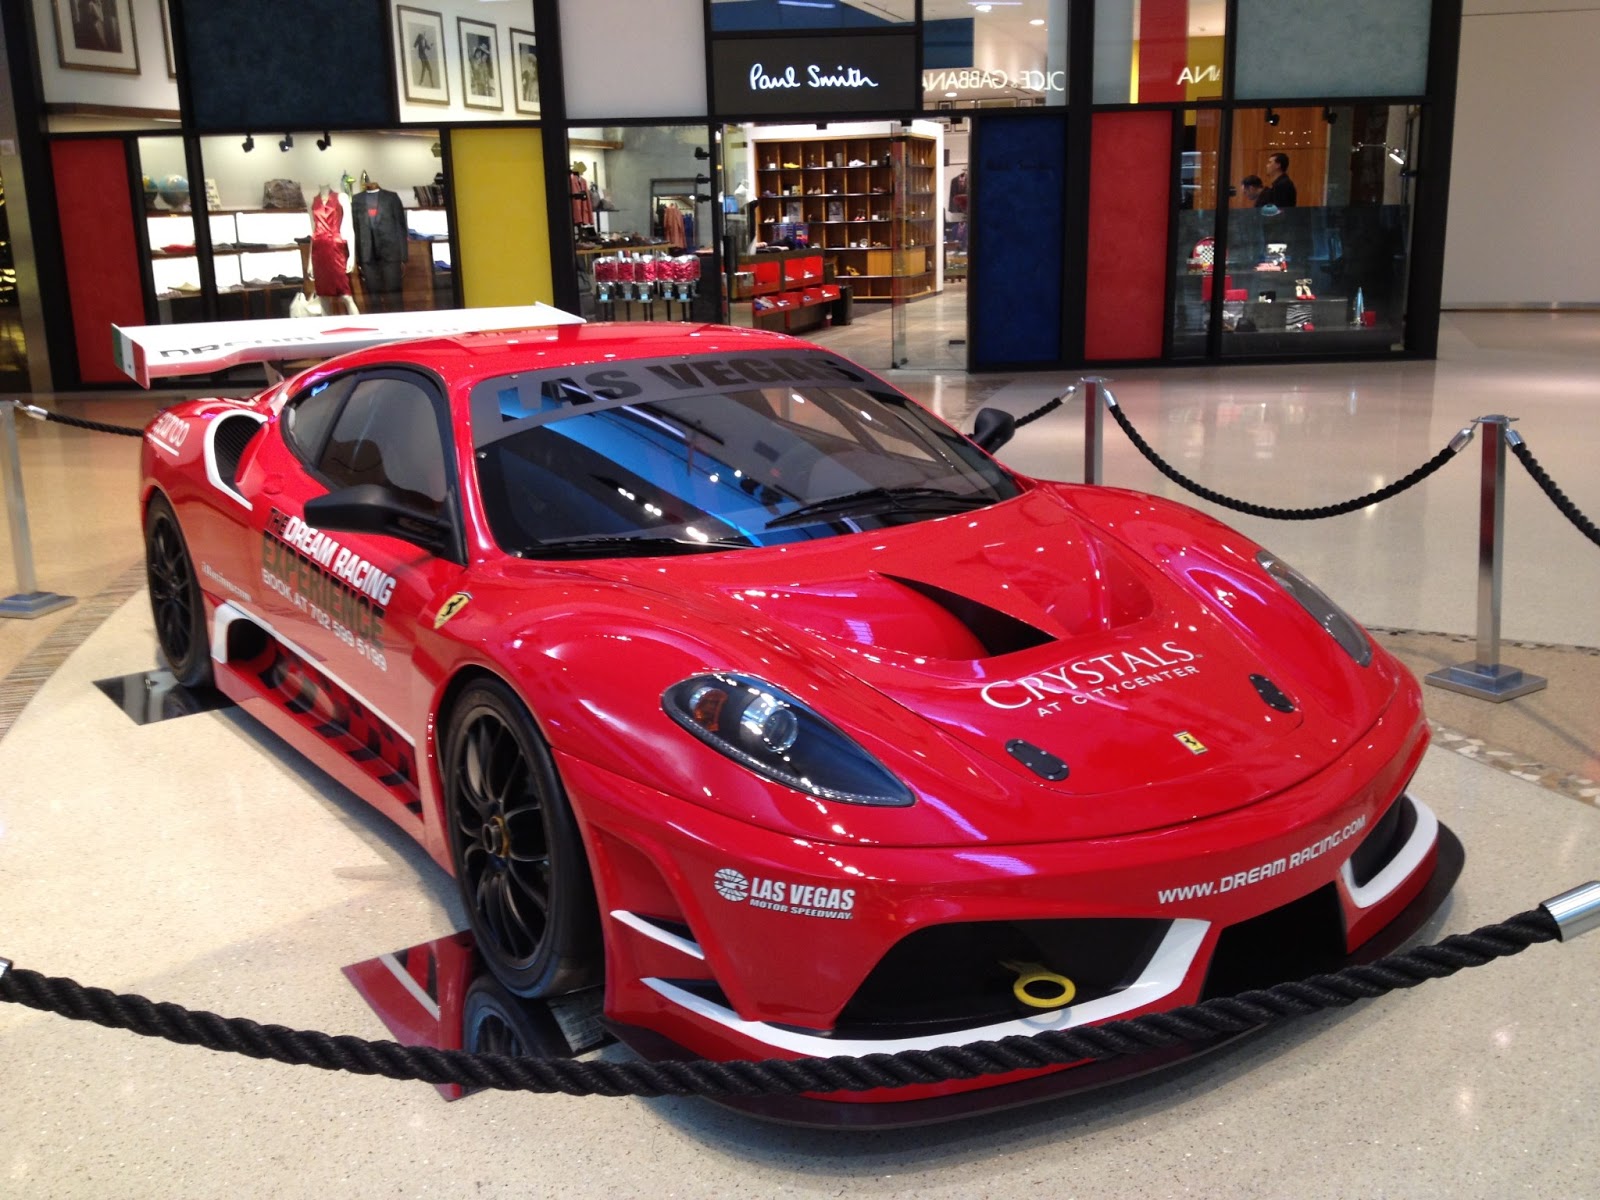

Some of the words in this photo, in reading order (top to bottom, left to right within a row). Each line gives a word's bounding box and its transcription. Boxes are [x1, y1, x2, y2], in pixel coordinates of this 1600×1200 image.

[749, 63, 801, 90] Paul
[806, 64, 879, 88] Smith
[497, 369, 643, 422] LAS
[645, 357, 865, 391] VEGAS
[261, 567, 293, 601] BOOK
[282, 515, 340, 568] DREAM
[332, 548, 396, 607] RACING
[262, 528, 386, 655] EXPERIENCE
[980, 641, 1194, 709] CRYSTALS
[1037, 701, 1062, 717] AT
[1071, 664, 1200, 705] CITYCENTER
[1157, 857, 1287, 904] WWW.DREAM
[1288, 814, 1366, 870] RACING.COM
[749, 898, 788, 913] MOTOR
[790, 906, 853, 920] SPEEDWAY
[750, 877, 787, 902] LAS
[789, 883, 856, 911] VEGAS
